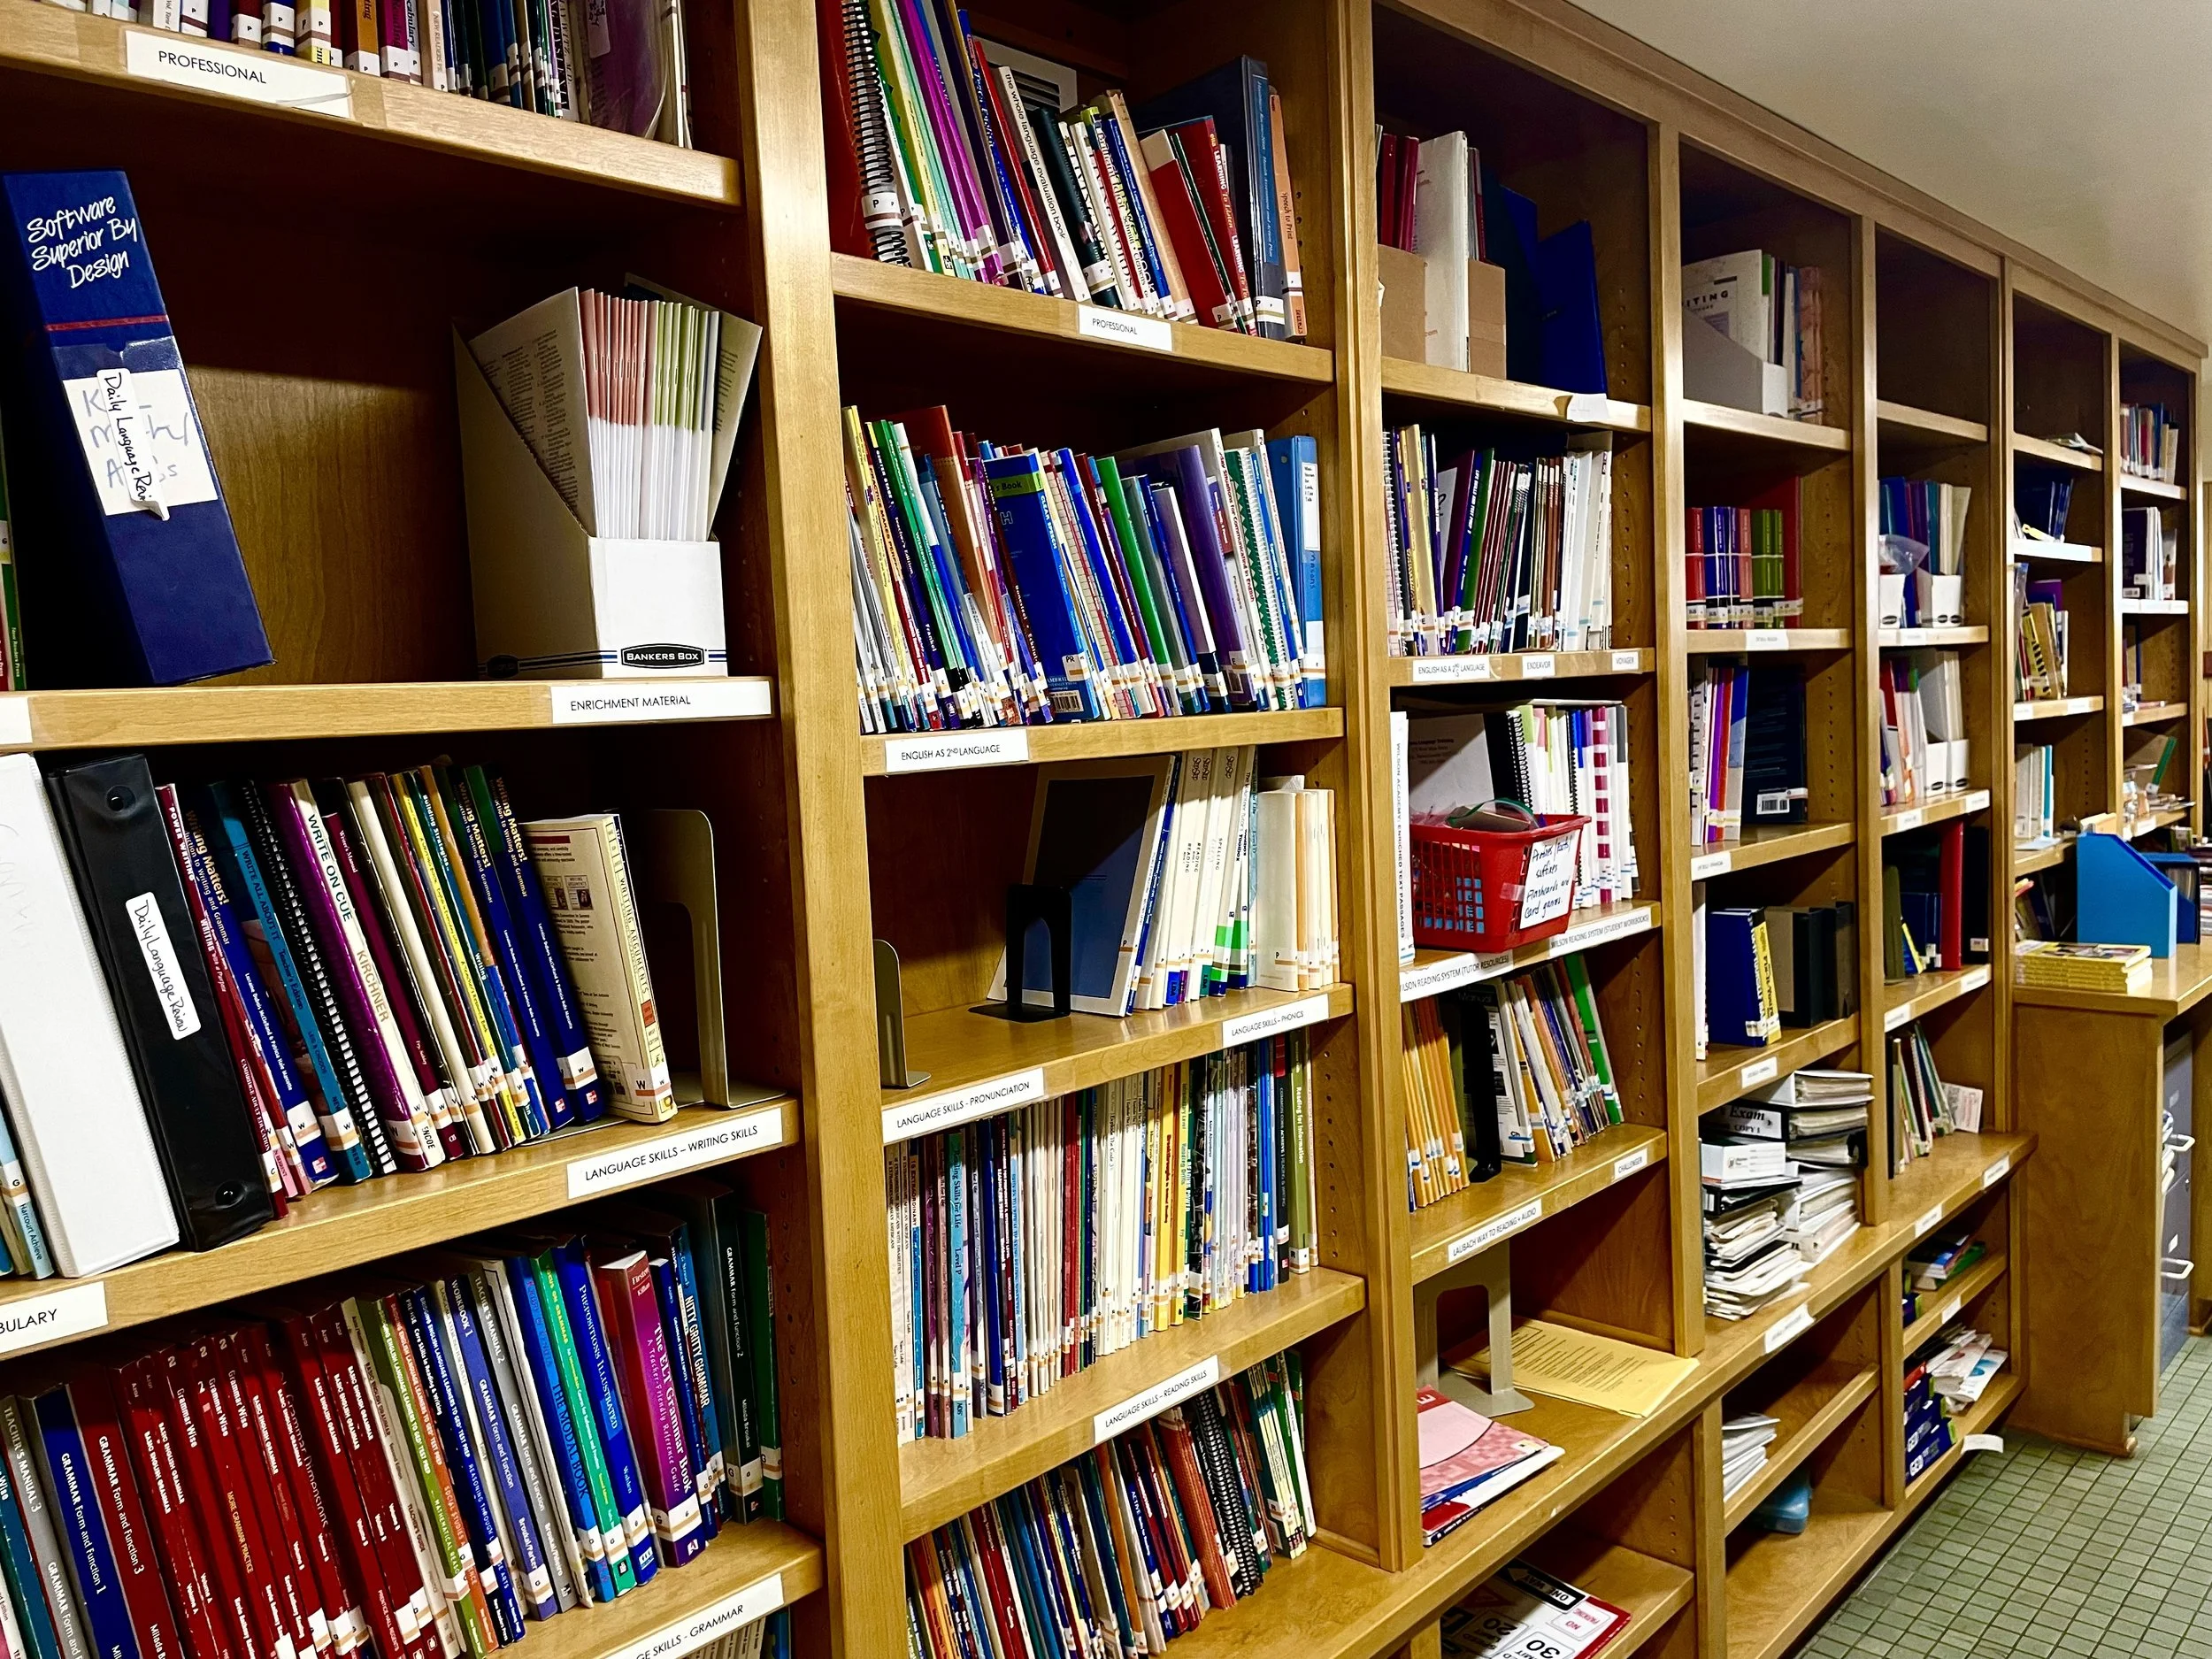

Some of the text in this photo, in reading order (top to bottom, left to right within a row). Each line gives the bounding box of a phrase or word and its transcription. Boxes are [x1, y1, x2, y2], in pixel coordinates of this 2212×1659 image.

[158, 50, 266, 84] PROFESSIONAL
[1005, 73, 1065, 240] the whole language evaluation book
[27, 196, 116, 243] Software
[32, 217, 137, 272] Superior By
[66, 250, 129, 289] Design
[1232, 234, 1245, 273] LEARNING
[1092, 317, 1138, 335] PROFESSIONAL
[104, 373, 122, 412] Daily
[1001, 480, 1023, 490] Book
[1041, 495, 1058, 549] CLEAR SPEECH
[1418, 664, 1439, 675] ENGLISH
[1461, 663, 1486, 672] LANGUAGE
[1526, 660, 1551, 671] ENDEAVOR
[571, 695, 691, 711] ENRICHMENT MATERIAL
[901, 749, 933, 760] ENGLISH
[935, 749, 945, 758] AS
[959, 744, 1001, 756] LANGUAGE
[423, 795, 436, 828] Building
[168, 806, 195, 882] POWER WRITING
[471, 823, 491, 868] Matters!
[507, 817, 528, 863] Matters!
[1184, 842, 1193, 873] READING
[202, 855, 230, 906] Matters!
[308, 813, 354, 922] WRITE ON CUE
[242, 850, 257, 881] WRITE
[260, 899, 277, 930] ABOUT
[271, 929, 280, 941] IT
[134, 899, 175, 1002] Daily Language
[620, 877, 650, 995] WRITING ARGUMENTS
[1569, 933, 1587, 945] READING
[1588, 927, 1603, 939] SYSTEM
[279, 948, 304, 1010] Teacher's Edition
[356, 949, 390, 1023] KIRCHNER
[475, 953, 487, 980] Writing
[1417, 974, 1440, 987] READING
[1441, 969, 1461, 981] SYSTEM
[1232, 1010, 1304, 1037] LANGUAGE SKILLS PHONICS
[896, 1081, 1030, 1128] LANGUAGE SKILLS PRONUNCIATION
[1729, 1105, 1765, 1121] Exam
[585, 1125, 758, 1181] LANGUAGE SKILLS WRITING SKILLS
[1617, 1156, 1643, 1174] CHALLENGER
[20, 1203, 42, 1261] Harcourt Achieve
[1453, 1207, 1537, 1256] LAUBACH WAY TO READING AUDIO
[451, 1279, 473, 1338] WORKBOOK 1
[475, 1276, 505, 1363] TEACHER'S MANUAL 2
[580, 1284, 618, 1430] PREPOSITIONS ILLUSTRATED
[683, 1294, 711, 1409] NITTY GRITTY GRAMMAR
[177, 1387, 197, 1448] Grammar Wise
[227, 1370, 248, 1428] Grammar Wise
[314, 1377, 341, 1455] BASIC ENGLISH GRAMMAR
[655, 1322, 691, 1495] The ELT Grammar Book
[1105, 1370, 1208, 1428] LANGUAGE SKILLS READING SKILLS
[4, 1406, 42, 1513] TEACHER'S MANUAL 3
[479, 1379, 514, 1489] GRAMMAR Form and Function
[552, 1382, 590, 1500] THE MODAL BOOK
[663, 1422, 675, 1460] Reference
[670, 1461, 680, 1493] Guide
[98, 1435, 145, 1575] GRAMMAR Form and Function 3
[468, 1463, 483, 1502] REASONING
[61, 1452, 107, 1595] GRAMMAR Form and Function 1
[227, 1490, 254, 1574] MORE GRAMMAR PRACTICE
[444, 1486, 465, 1541] SOCIAL STUDIES
[47, 1563, 74, 1638] GRAMMAR Form
[1522, 1574, 1570, 1601] ONE WAY
[653, 1604, 744, 1658] SKILLS GRAMMAR
[1483, 1617, 1517, 1636] 20
[1526, 1639, 1561, 1658] 30
[1565, 1620, 1582, 1630] NO
